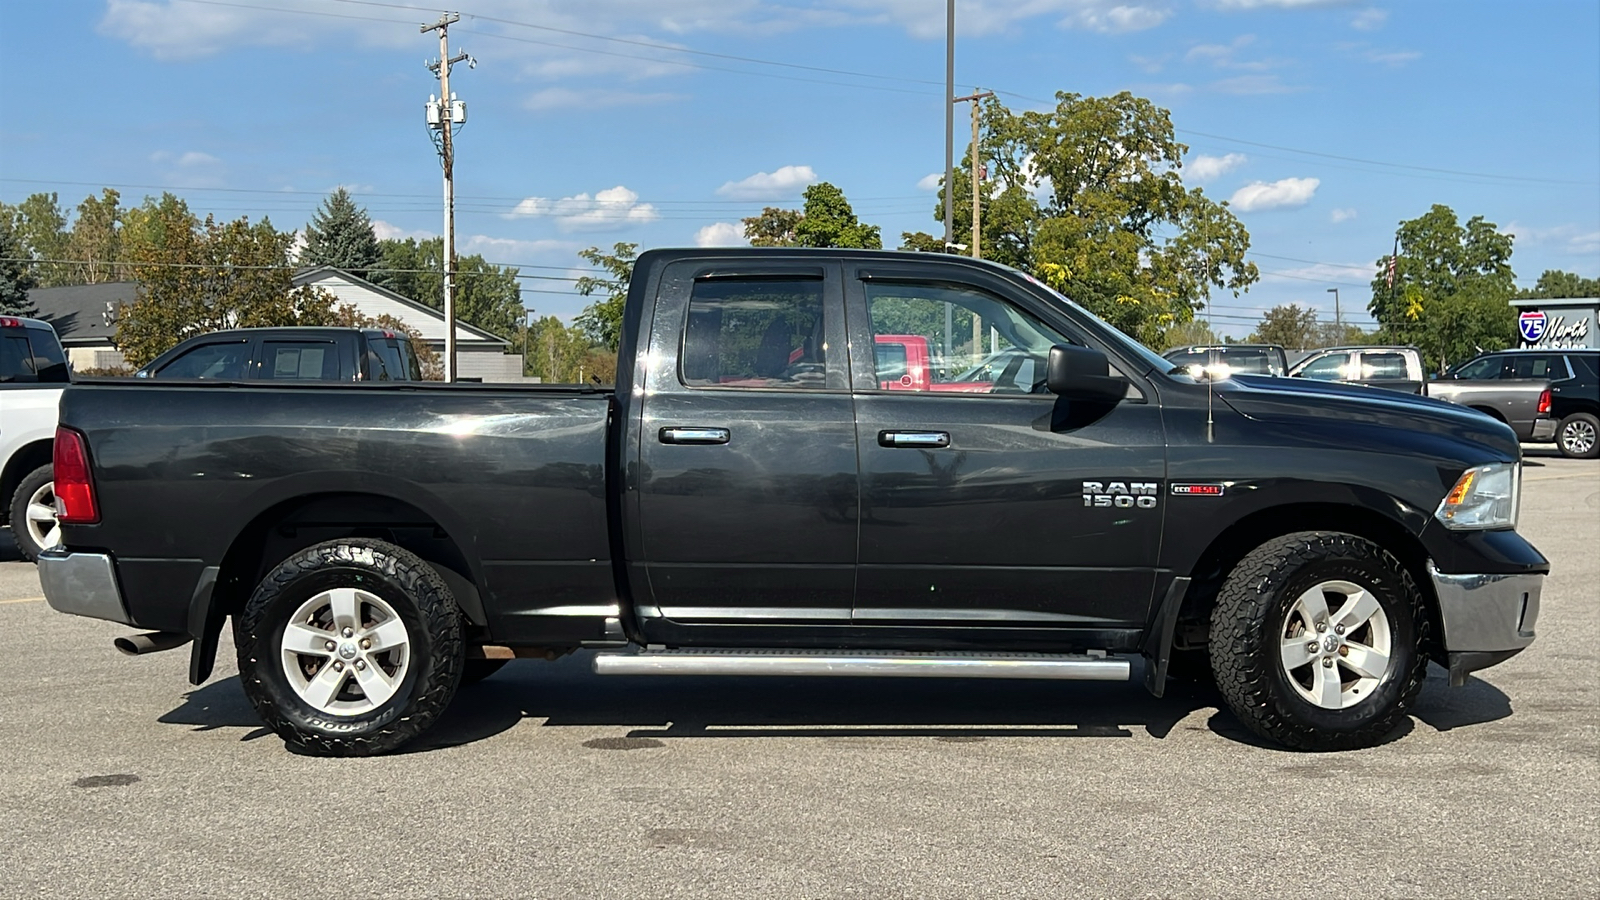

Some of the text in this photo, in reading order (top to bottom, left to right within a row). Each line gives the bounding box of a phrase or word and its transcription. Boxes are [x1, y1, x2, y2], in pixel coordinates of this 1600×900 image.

[1524, 316, 1587, 339] 75 North
[1082, 481, 1157, 494] RAM
[1082, 495, 1157, 508] 1500
